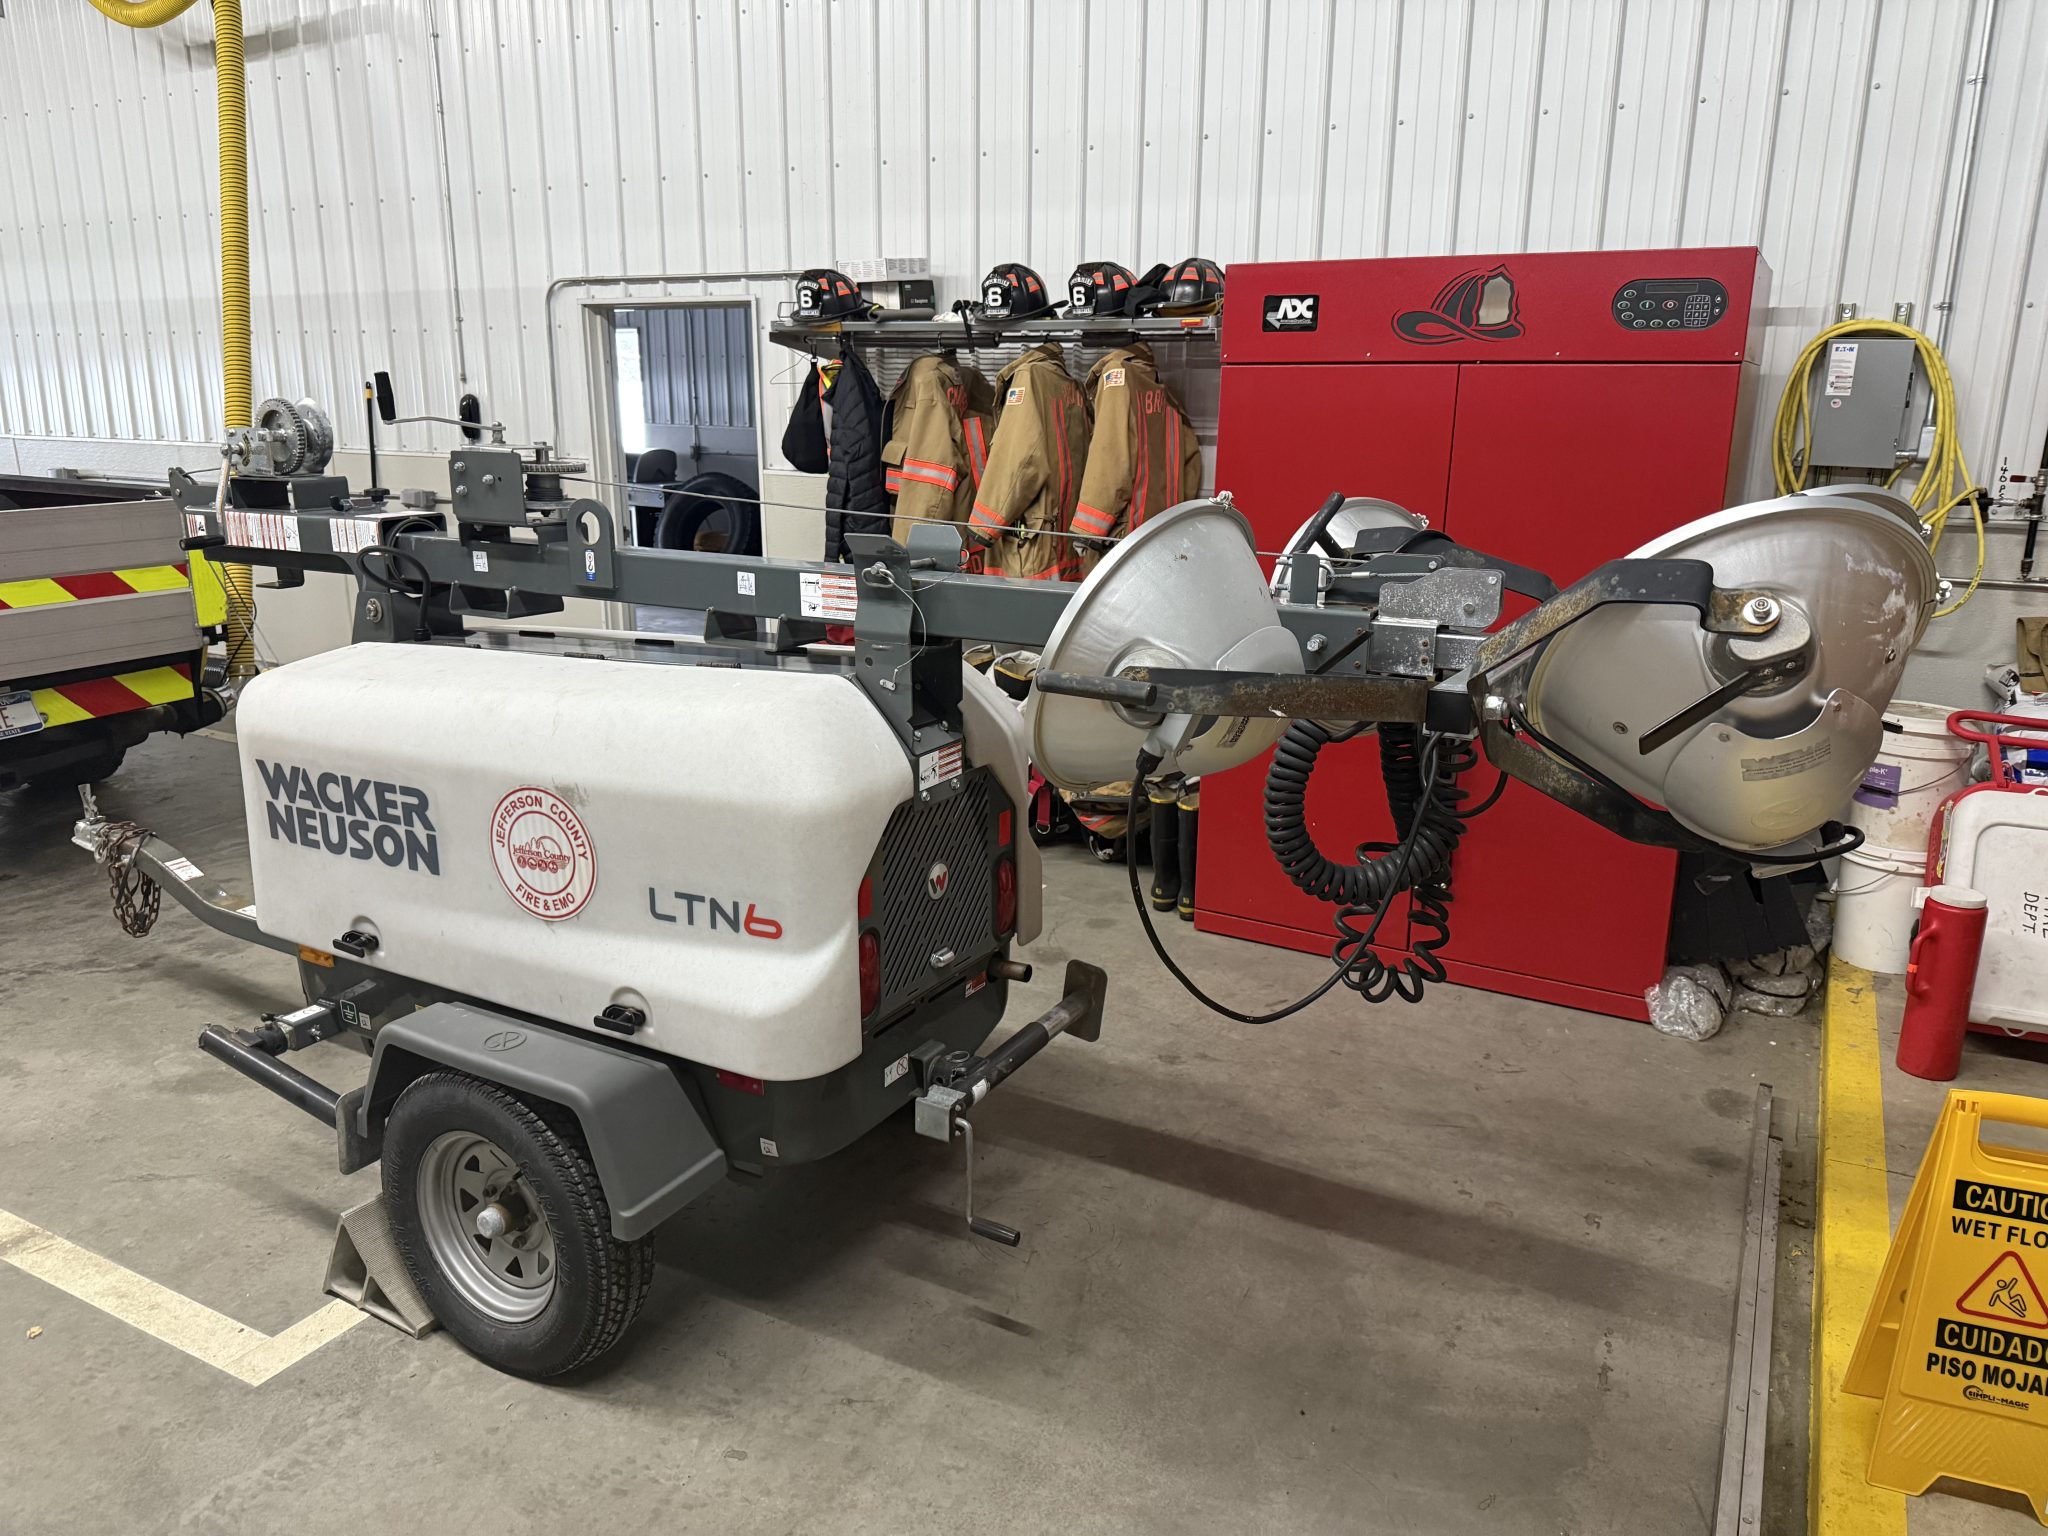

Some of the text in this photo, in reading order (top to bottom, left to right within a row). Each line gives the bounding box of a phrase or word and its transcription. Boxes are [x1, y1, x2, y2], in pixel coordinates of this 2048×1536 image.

[800, 289, 812, 308] 6
[988, 286, 1002, 307] 6
[1072, 286, 1085, 307] 6
[1277, 297, 1314, 319] ADC
[255, 758, 437, 833] WACKER
[266, 800, 440, 876] NEUSON
[495, 795, 588, 861] JEFFERSON COUNTY
[512, 843, 571, 864] Jefferson County
[515, 883, 576, 911] FIRE & EMO
[648, 886, 783, 940] LTN6
[2022, 891, 2040, 934] DEPT.
[1951, 1215, 2002, 1241] WET
[1944, 1323, 2048, 1367] CUIDAD
[1926, 1352, 2048, 1397] PISO MOJA
[1967, 1389, 2030, 1410] SIMPLI-MAGIC
